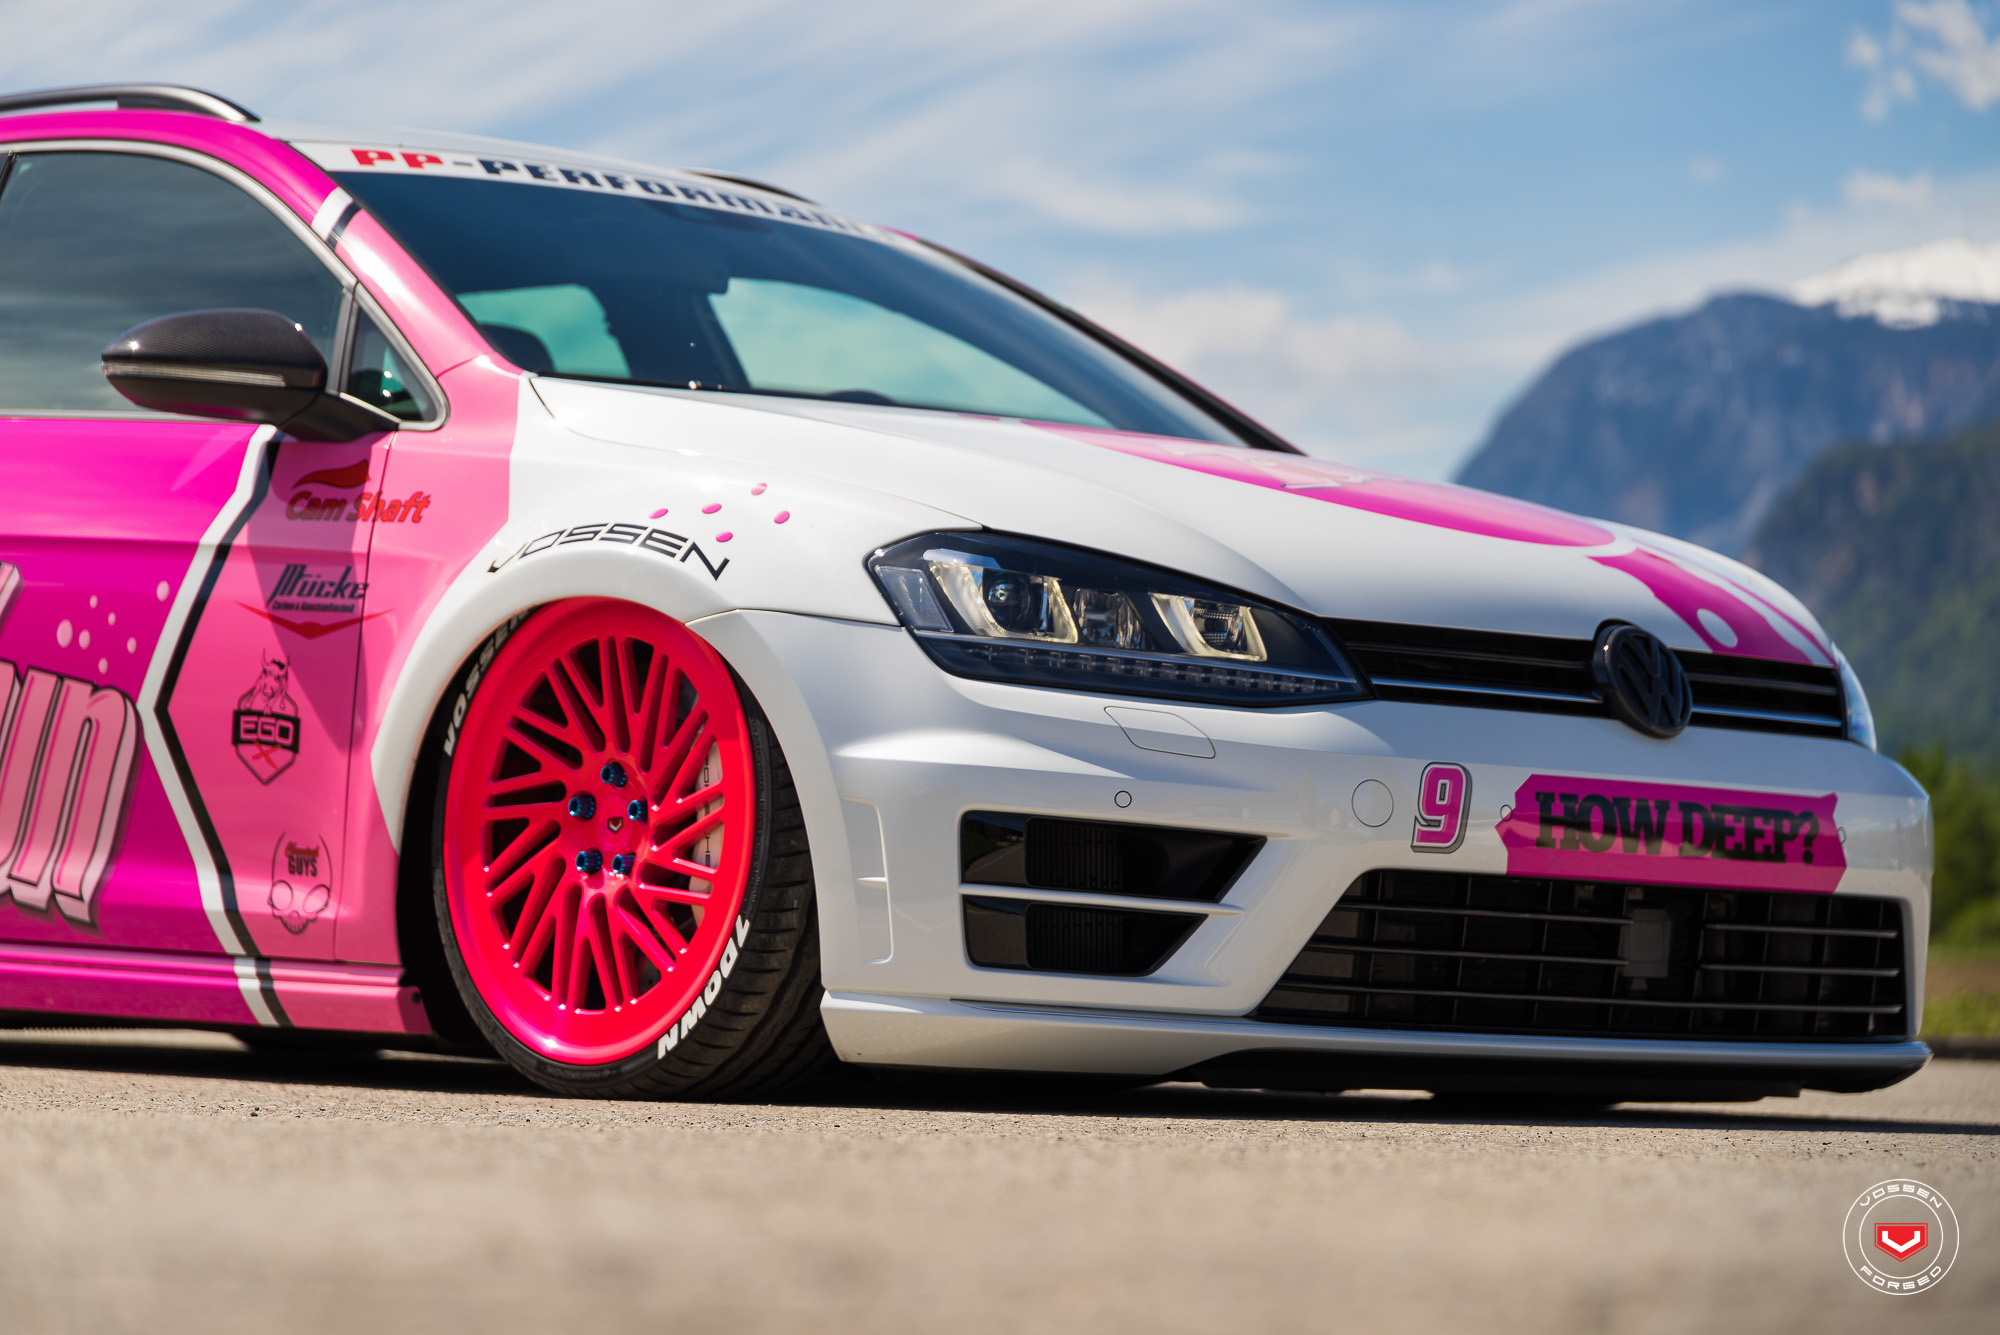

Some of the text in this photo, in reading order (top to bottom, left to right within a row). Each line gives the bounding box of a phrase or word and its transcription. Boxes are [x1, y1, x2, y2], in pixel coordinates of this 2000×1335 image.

[285, 490, 432, 523] Cam Shaft
[486, 523, 731, 581] VOSSEN
[239, 715, 295, 746] EGO
[1411, 761, 1473, 853] 9
[1535, 792, 1820, 866] HOW DEEP?
[288, 855, 318, 877] GUYS
